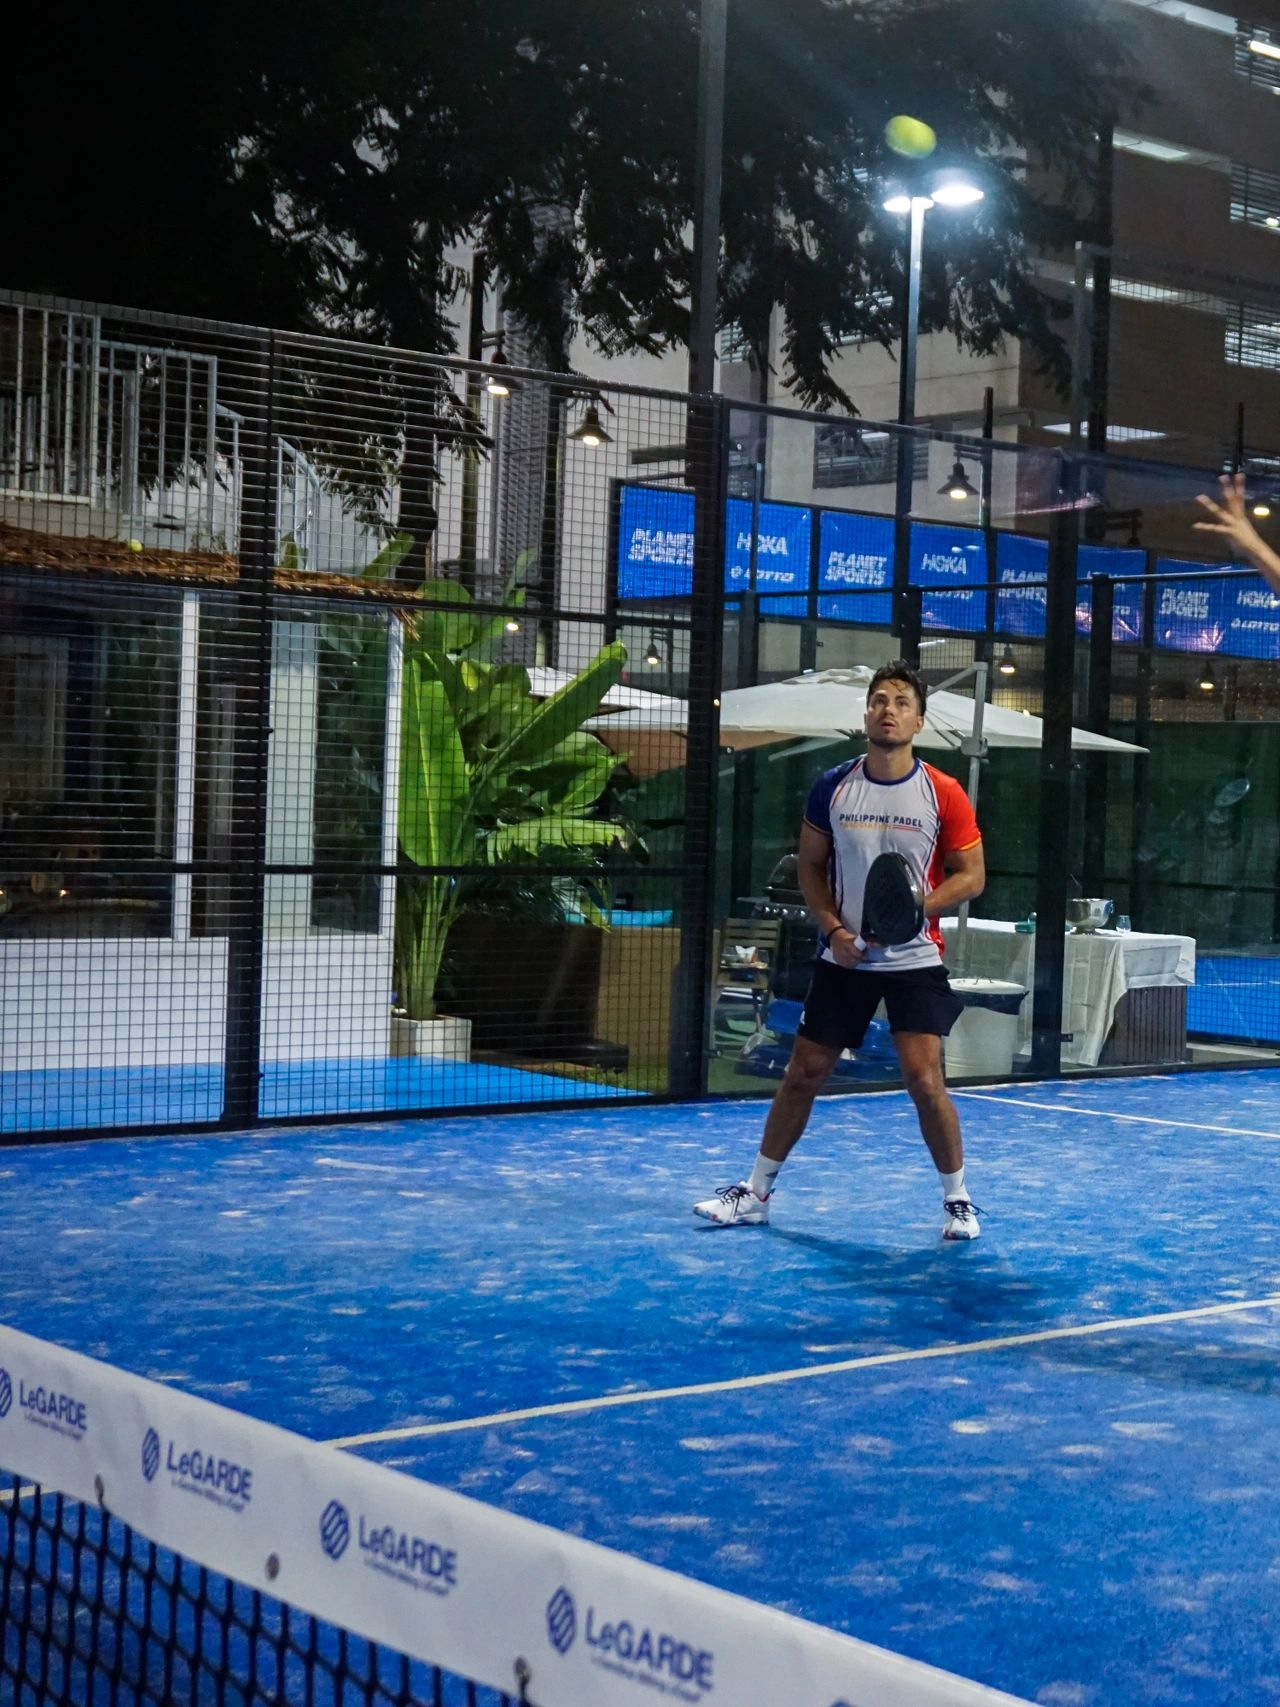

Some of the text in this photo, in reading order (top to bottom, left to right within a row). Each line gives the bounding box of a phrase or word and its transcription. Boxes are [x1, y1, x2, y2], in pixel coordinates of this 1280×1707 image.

[828, 551, 887, 571] PLANET
[921, 553, 967, 574] HOKA
[825, 566, 886, 585] SPORTS
[1001, 569, 1048, 583] PLANE
[1162, 588, 1210, 604] PLANET
[1160, 602, 1209, 618] SPORTS
[839, 813, 890, 825] PHILIPPINE
[893, 815, 923, 828] PADEL
[19, 1378, 87, 1431] LeGARDE
[167, 1440, 252, 1502] LeGARDE
[358, 1515, 457, 1585] LeGARDE
[585, 1606, 714, 1692] LeGARDE
